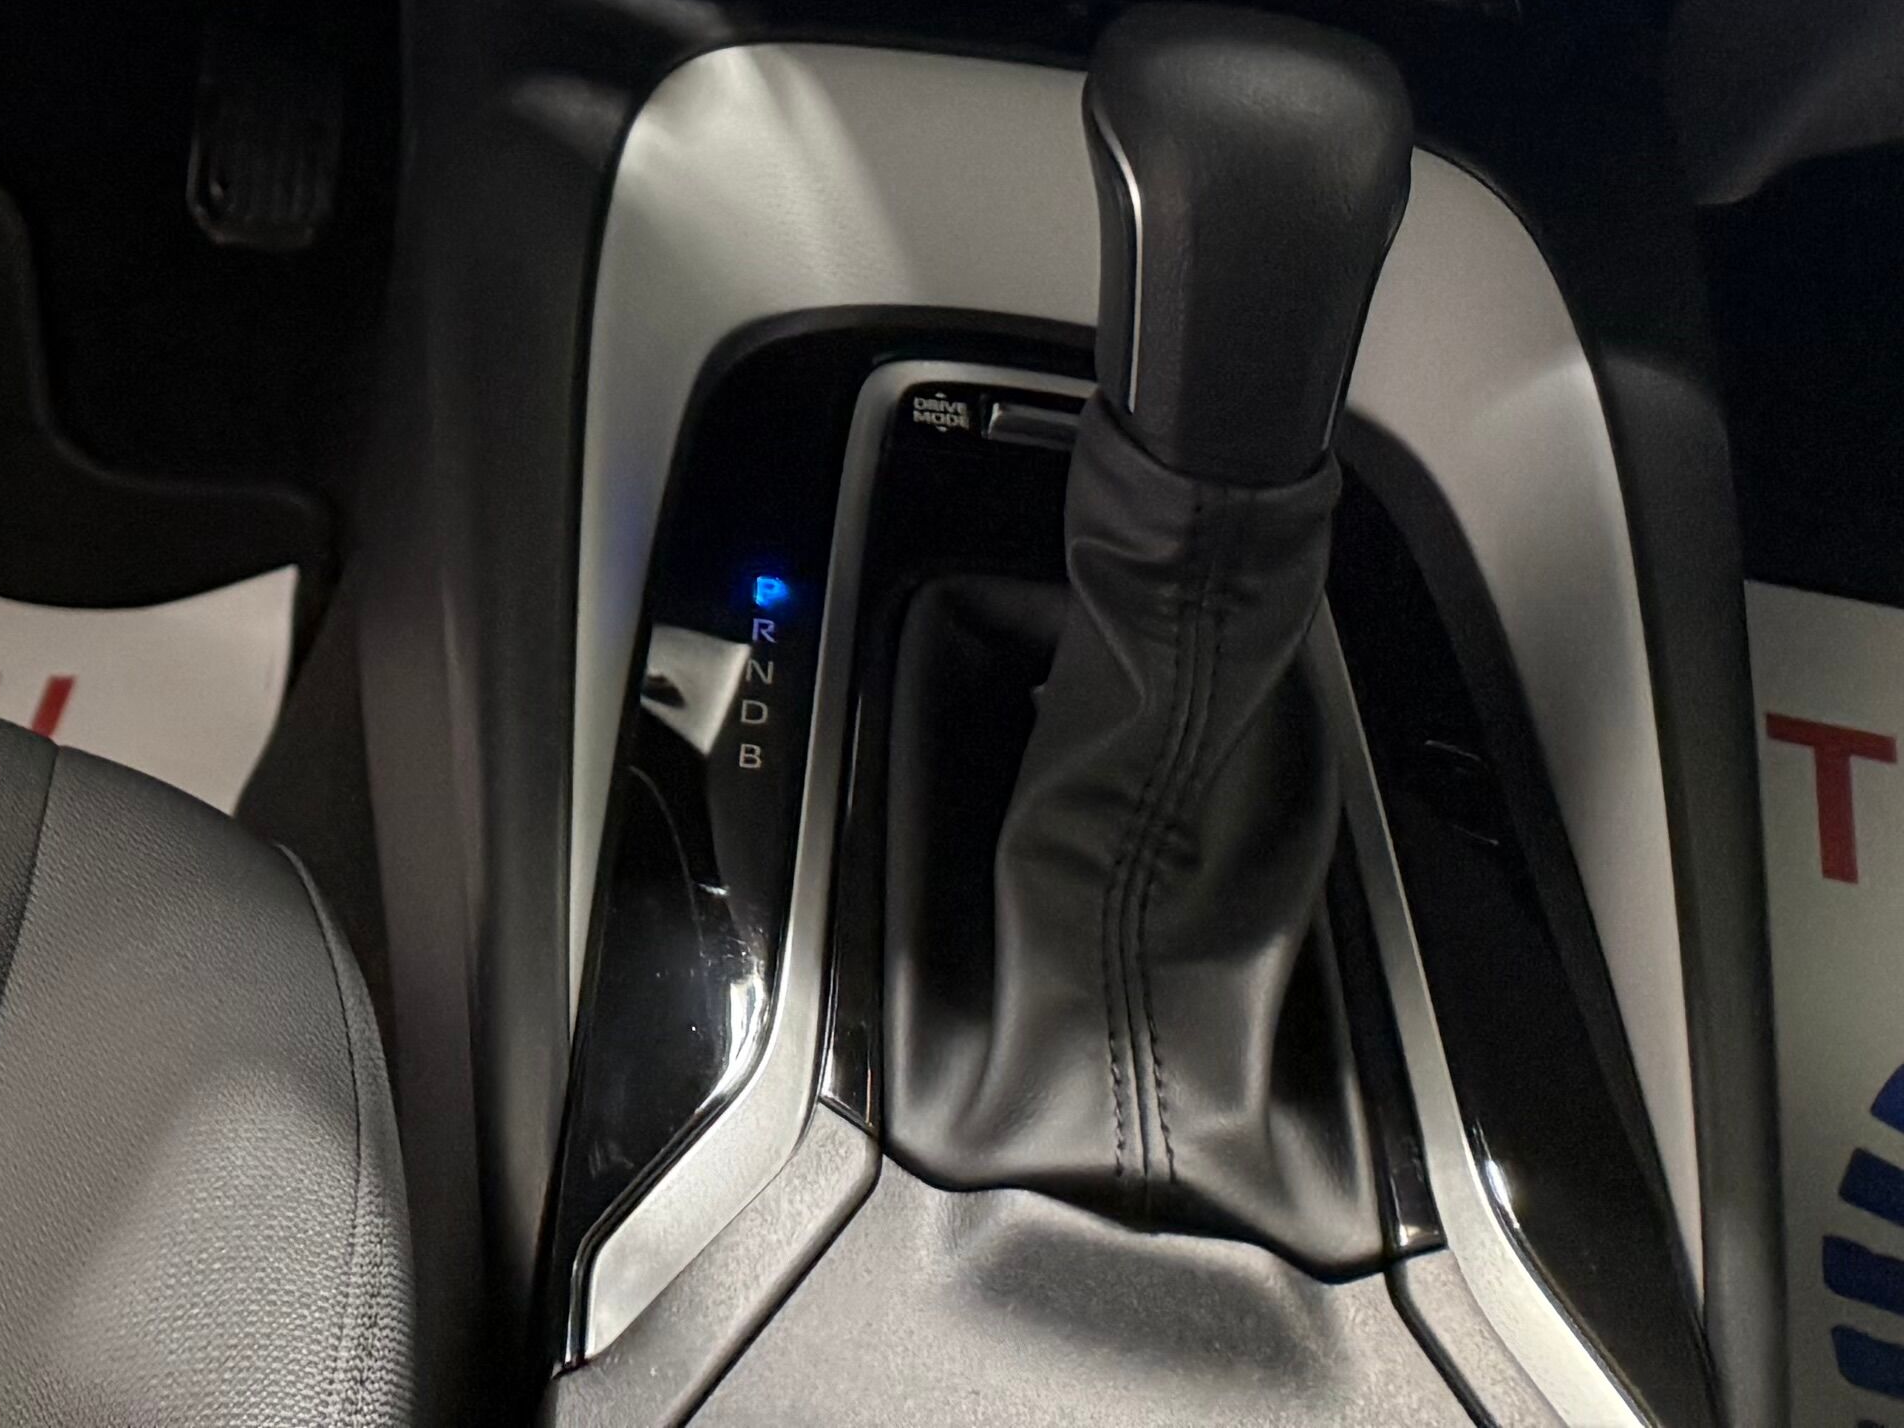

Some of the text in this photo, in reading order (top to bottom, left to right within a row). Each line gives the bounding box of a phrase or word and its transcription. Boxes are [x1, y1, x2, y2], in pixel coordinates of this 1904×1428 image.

[913, 397, 967, 415] DRIVE
[913, 410, 970, 431] MODE
[755, 575, 788, 607] P
[751, 618, 776, 644] R
[745, 659, 774, 685] N
[740, 700, 768, 726] D
[739, 745, 762, 769] B
